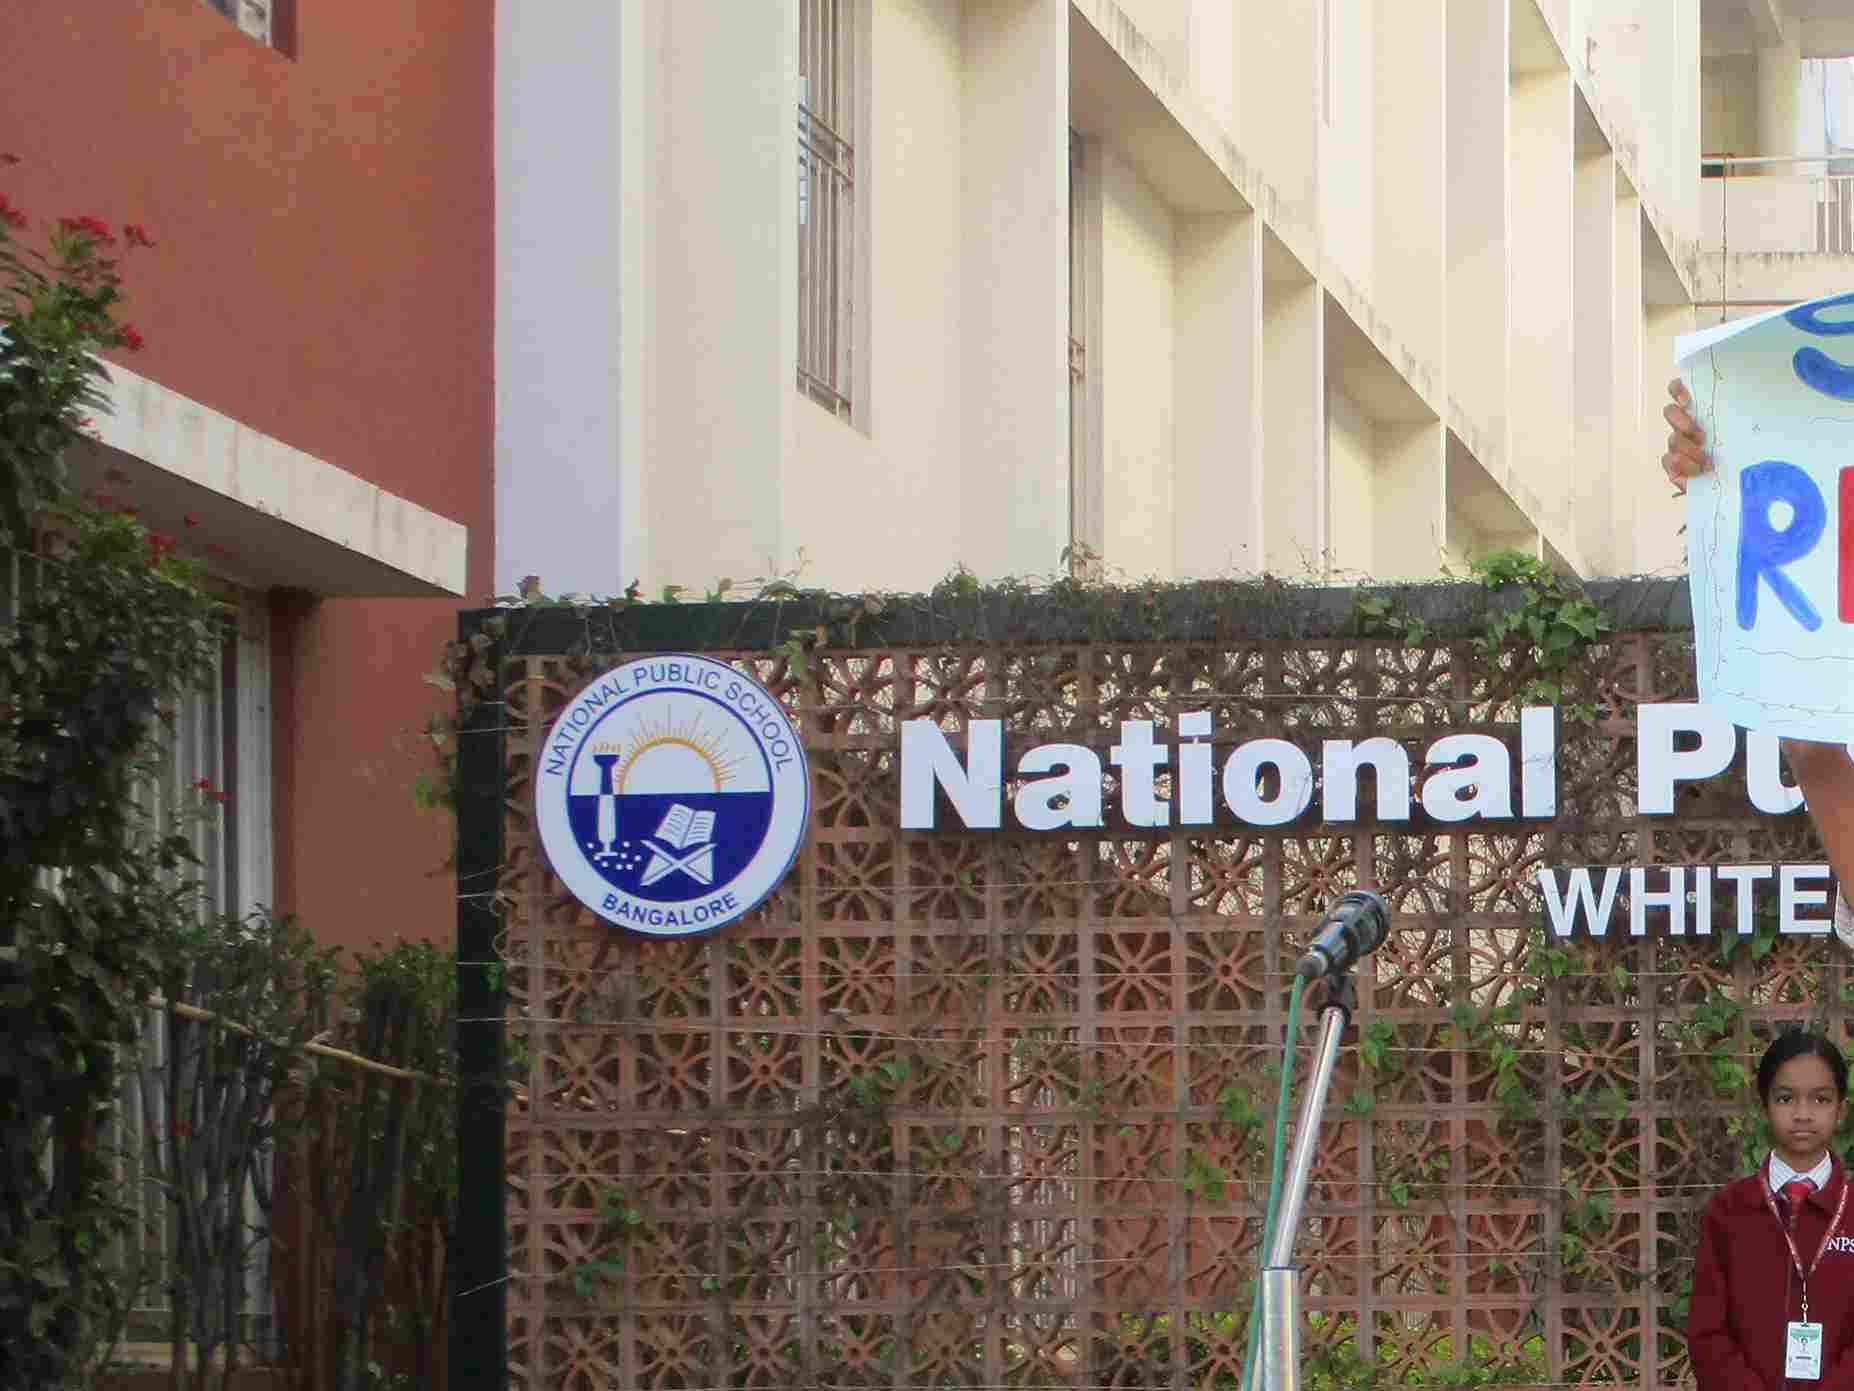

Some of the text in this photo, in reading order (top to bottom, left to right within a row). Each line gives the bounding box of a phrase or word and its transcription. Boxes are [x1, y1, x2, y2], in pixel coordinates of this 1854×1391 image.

[546, 662, 794, 775] NATIONAL PUBLIC SCHOOL
[900, 706, 1556, 829] National
[601, 891, 739, 928] BANGALORE
